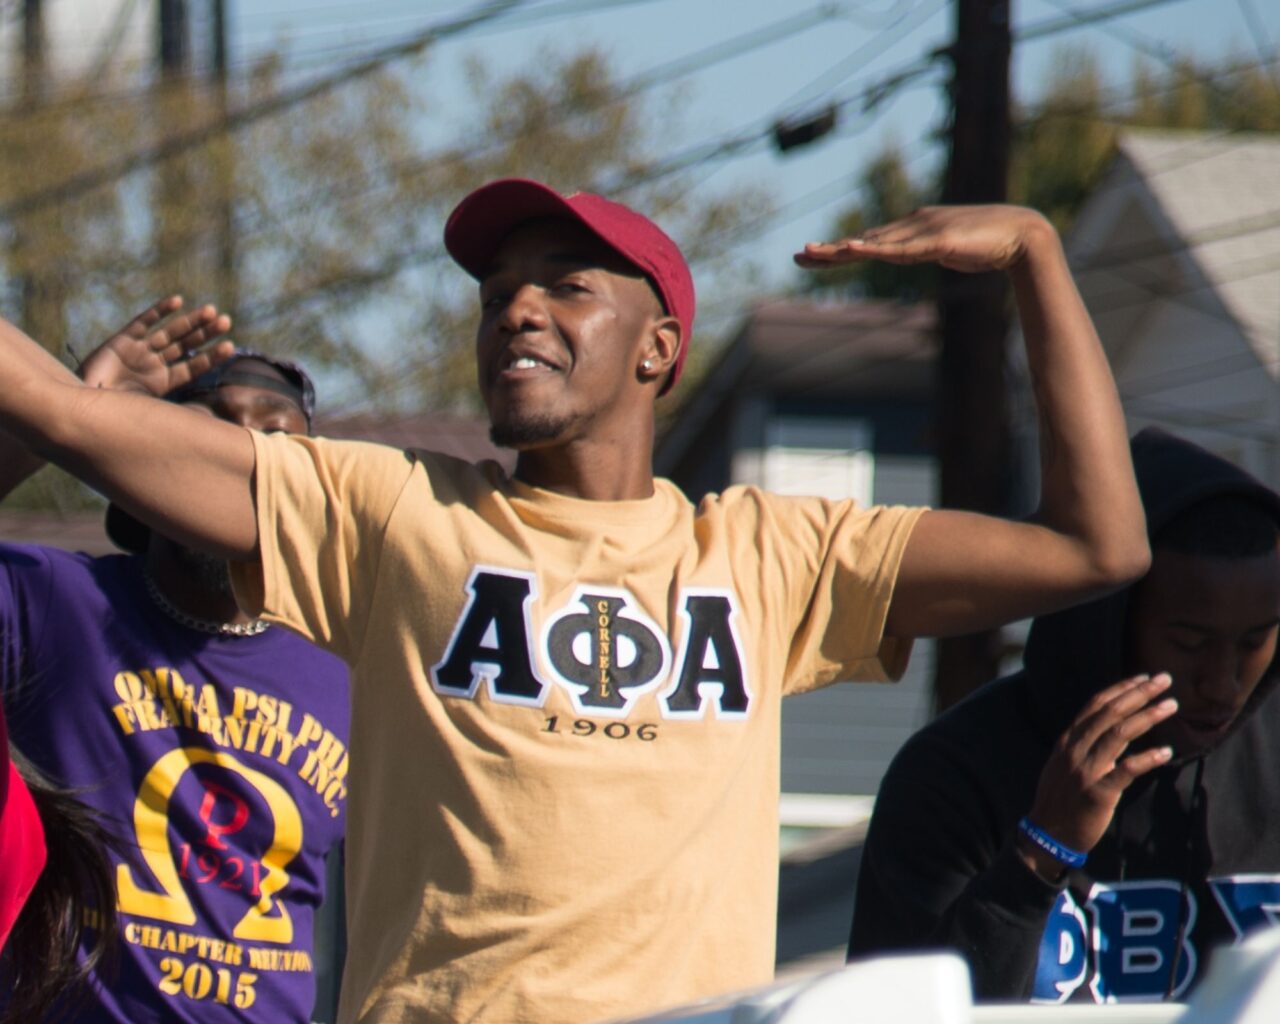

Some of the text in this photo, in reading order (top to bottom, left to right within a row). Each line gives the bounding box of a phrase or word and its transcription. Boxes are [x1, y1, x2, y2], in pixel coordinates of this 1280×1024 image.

[597, 600, 610, 698] CORNELL
[233, 686, 293, 731] PSI
[539, 715, 659, 742] 1906
[298, 750, 347, 818] INC.
[178, 843, 261, 897] 1921
[125, 922, 244, 966] CHAPTER
[158, 957, 258, 1009] 2015
